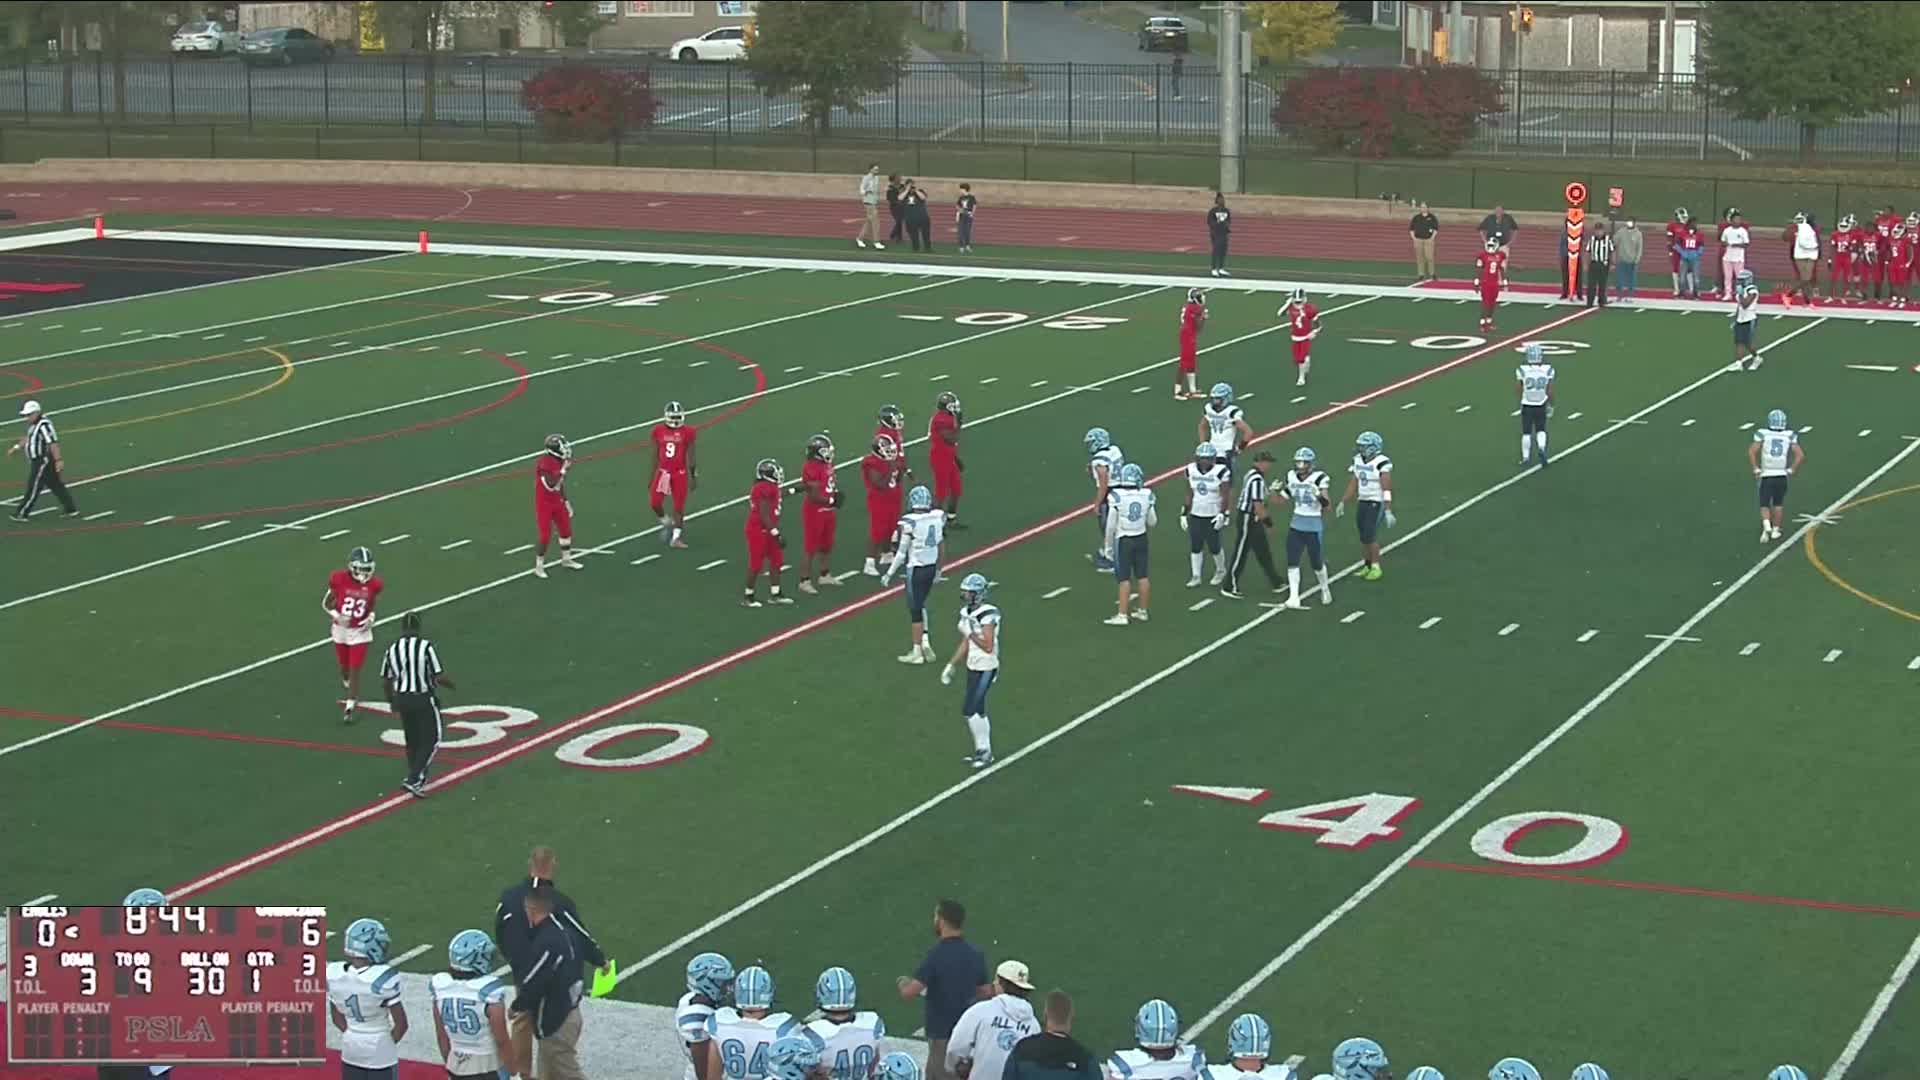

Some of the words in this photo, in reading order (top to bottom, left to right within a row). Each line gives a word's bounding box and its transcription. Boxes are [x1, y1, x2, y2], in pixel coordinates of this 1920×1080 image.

[665, 442, 675, 457] 9
[1771, 439, 1783, 457] 5
[1127, 502, 1142, 521] 8
[341, 597, 366, 617] 23
[345, 994, 365, 1022] 1
[441, 998, 481, 1035] 45
[991, 1015, 1014, 1029] ALL
[1016, 1020, 1031, 1035] IN
[722, 1038, 770, 1079] 64
